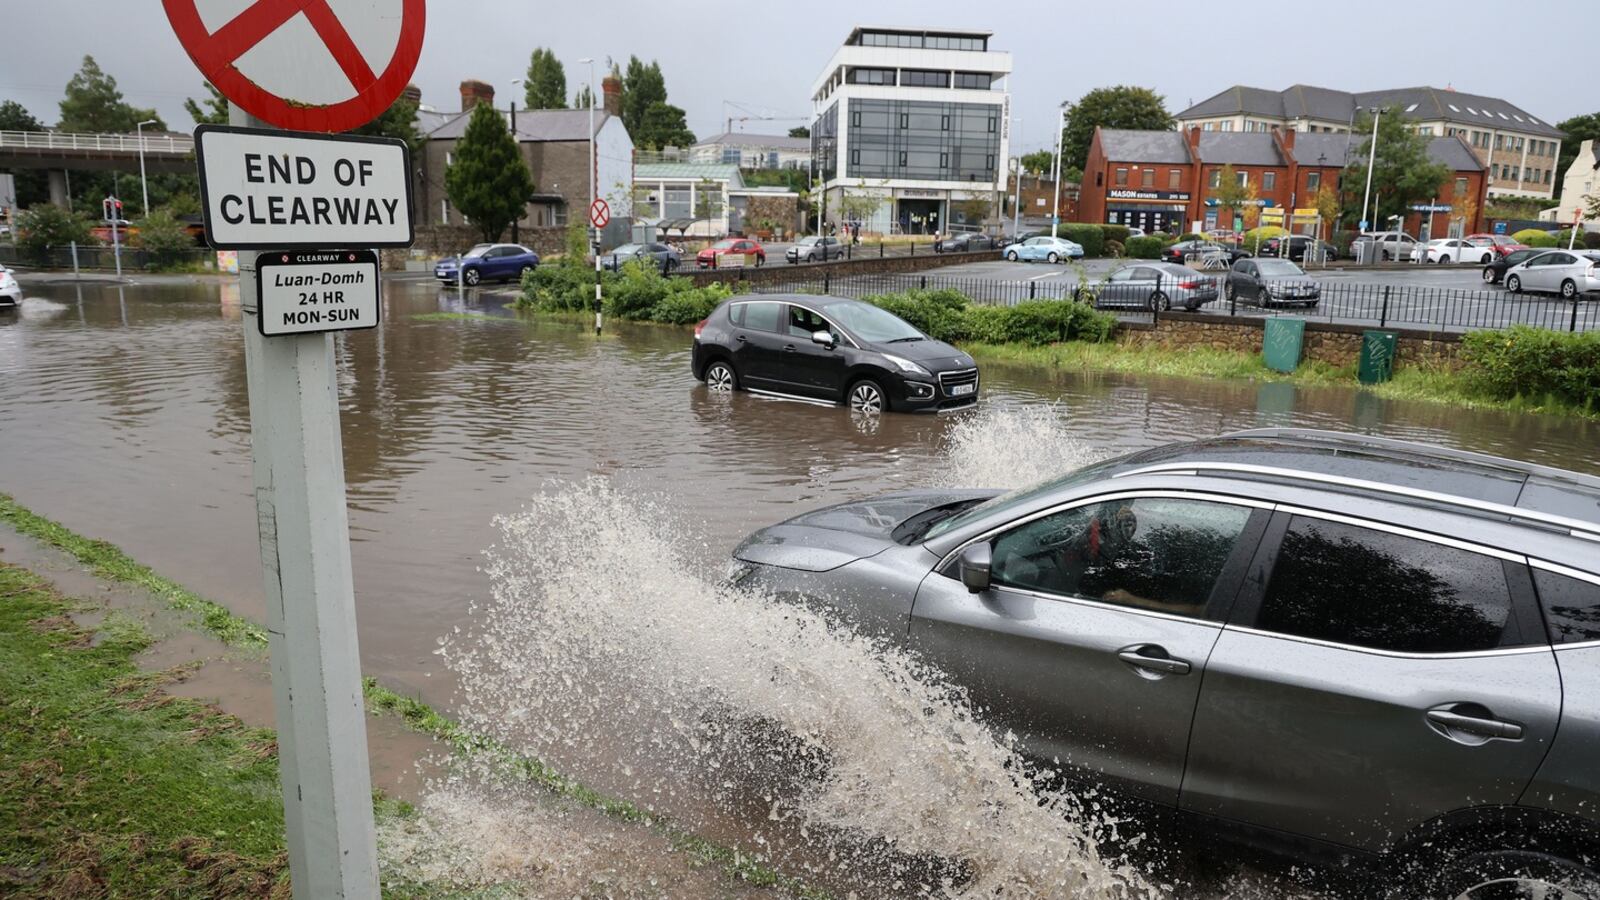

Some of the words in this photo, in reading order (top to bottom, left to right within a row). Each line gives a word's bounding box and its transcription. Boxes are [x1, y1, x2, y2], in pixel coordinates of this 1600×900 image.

[245, 153, 316, 185] END
[334, 158, 373, 187] OF
[1110, 190, 1137, 198] MASON
[220, 194, 399, 225] CLEARWAY
[296, 254, 340, 262] CLEARWAY
[275, 271, 365, 287] Luan-Domh
[298, 292, 318, 306] 24
[323, 291, 344, 304] HR
[283, 308, 360, 325] MON-SUN
